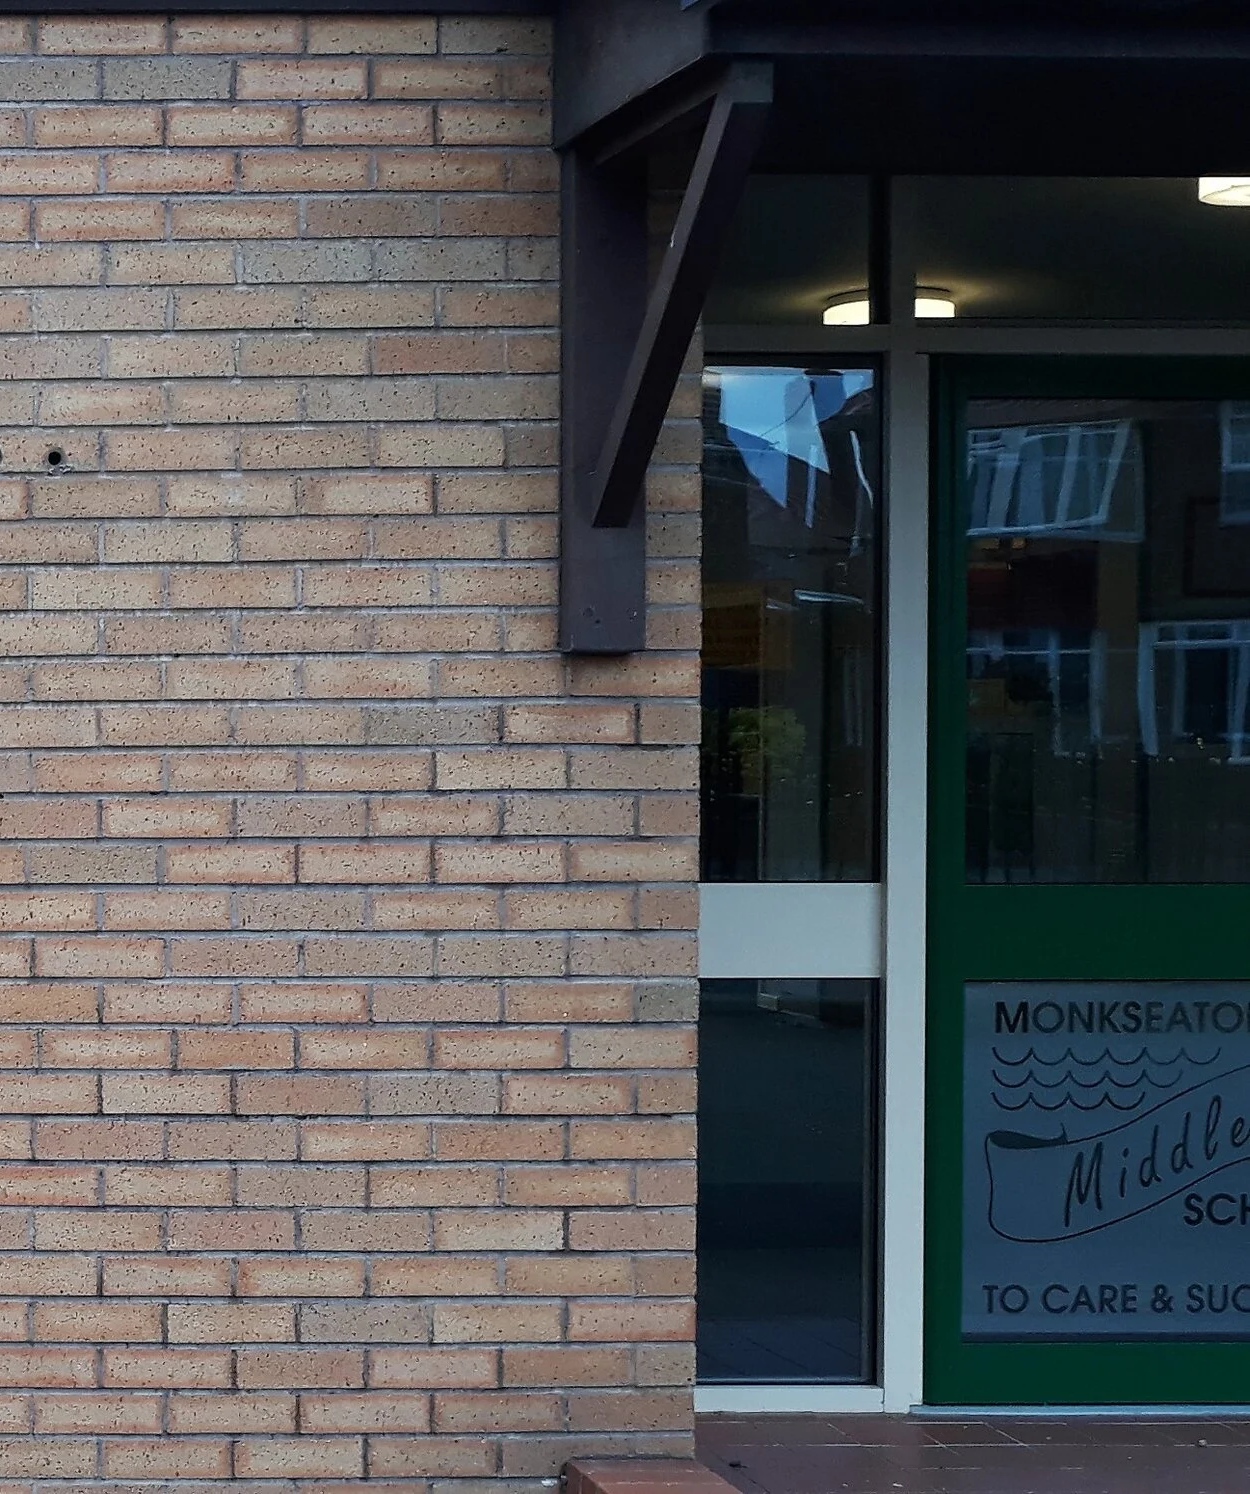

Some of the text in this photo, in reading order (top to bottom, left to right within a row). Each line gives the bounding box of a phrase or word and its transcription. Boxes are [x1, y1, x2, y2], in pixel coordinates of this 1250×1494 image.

[994, 1001, 1250, 1034] MONKSEATO
[1064, 1095, 1250, 1227] Middle
[982, 1284, 1029, 1314] TO
[1042, 1284, 1138, 1314] CARE
[1151, 1284, 1174, 1313] &
